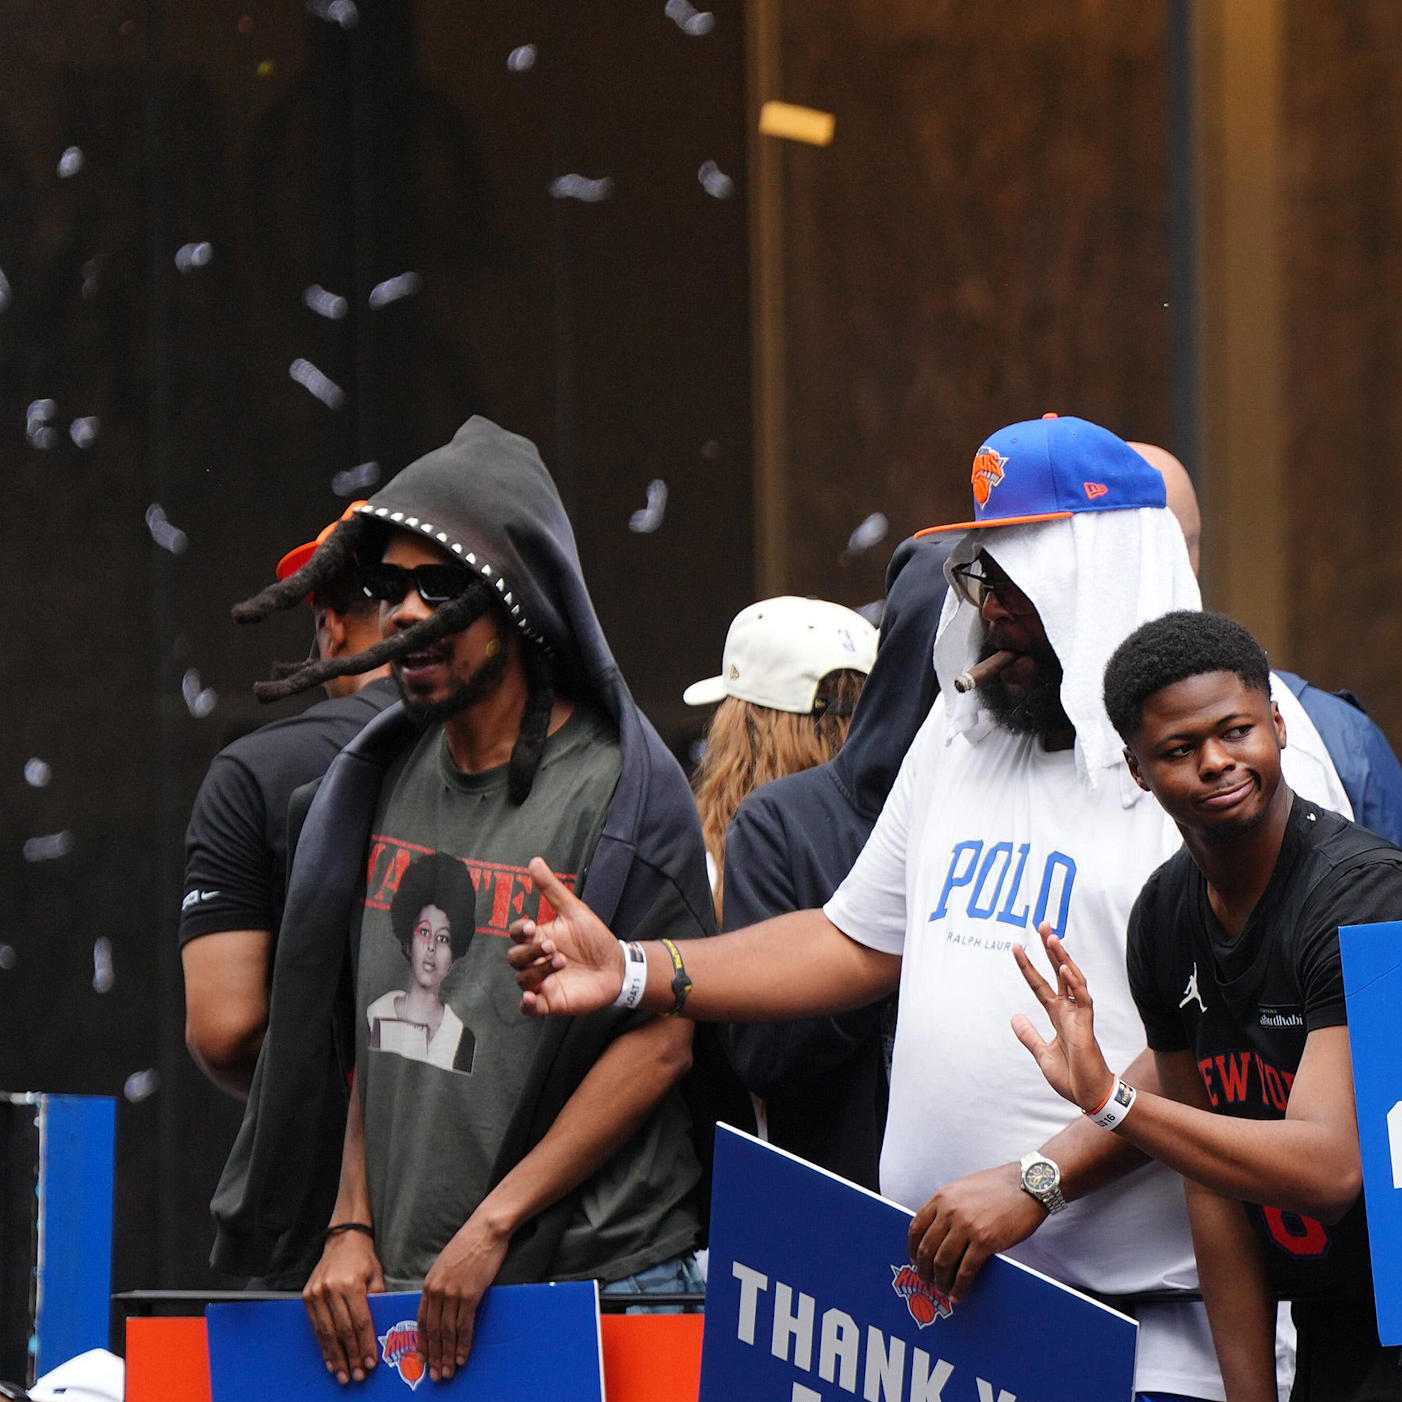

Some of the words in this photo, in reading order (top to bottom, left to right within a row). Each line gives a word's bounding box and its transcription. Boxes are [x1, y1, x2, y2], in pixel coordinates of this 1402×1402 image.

[928, 840, 1077, 940] POLO
[947, 931, 982, 946] RALPH
[985, 938, 1027, 952] LAUR
[1197, 1052, 1251, 1107] EW
